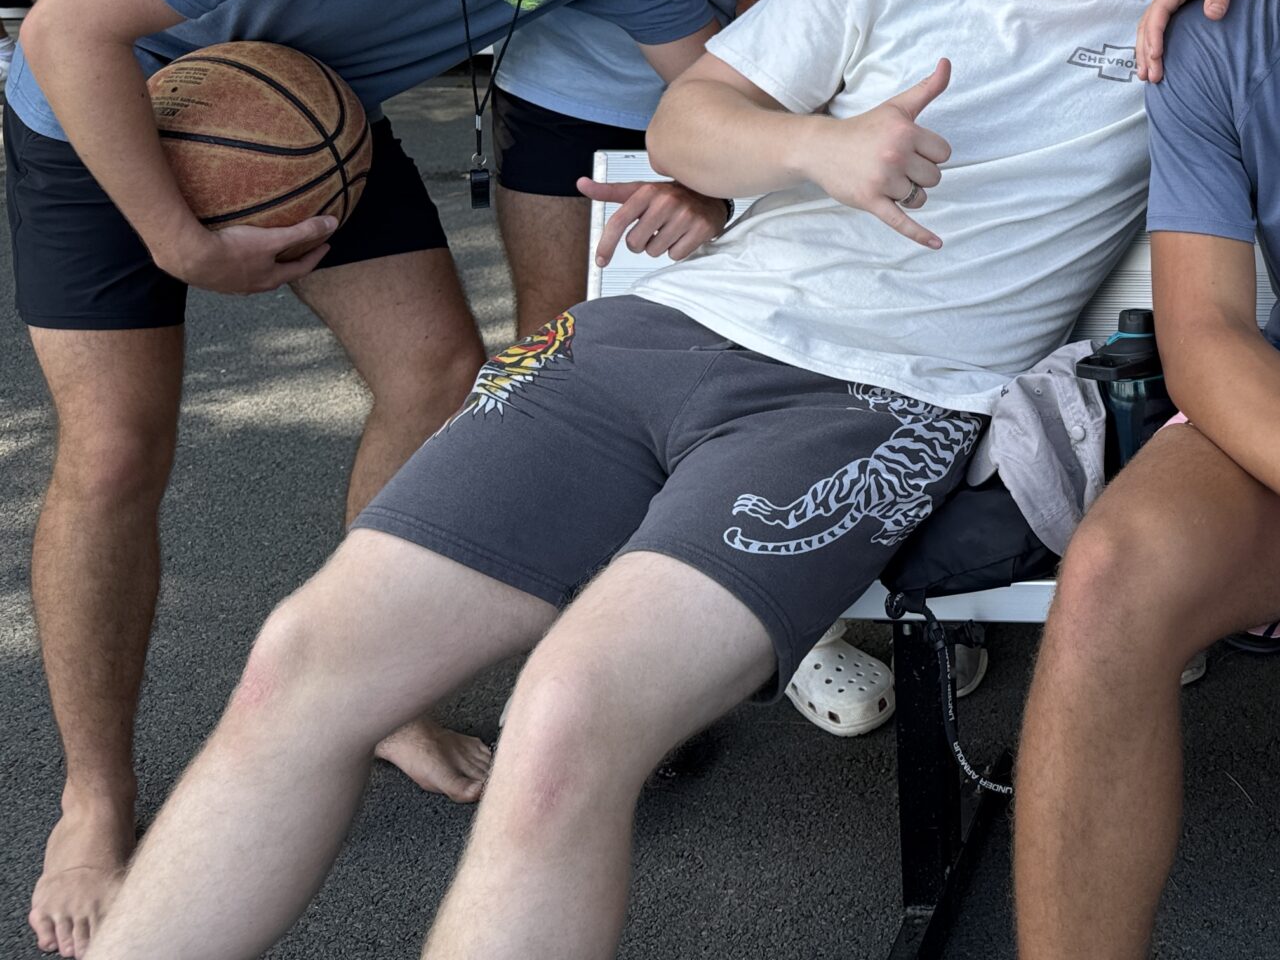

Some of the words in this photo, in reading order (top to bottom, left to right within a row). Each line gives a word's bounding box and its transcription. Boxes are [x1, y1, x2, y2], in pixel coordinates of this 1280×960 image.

[1078, 52, 1136, 69] CHEVRO
[953, 741, 979, 780] ARMOUR
[979, 777, 1013, 794] UNDER
